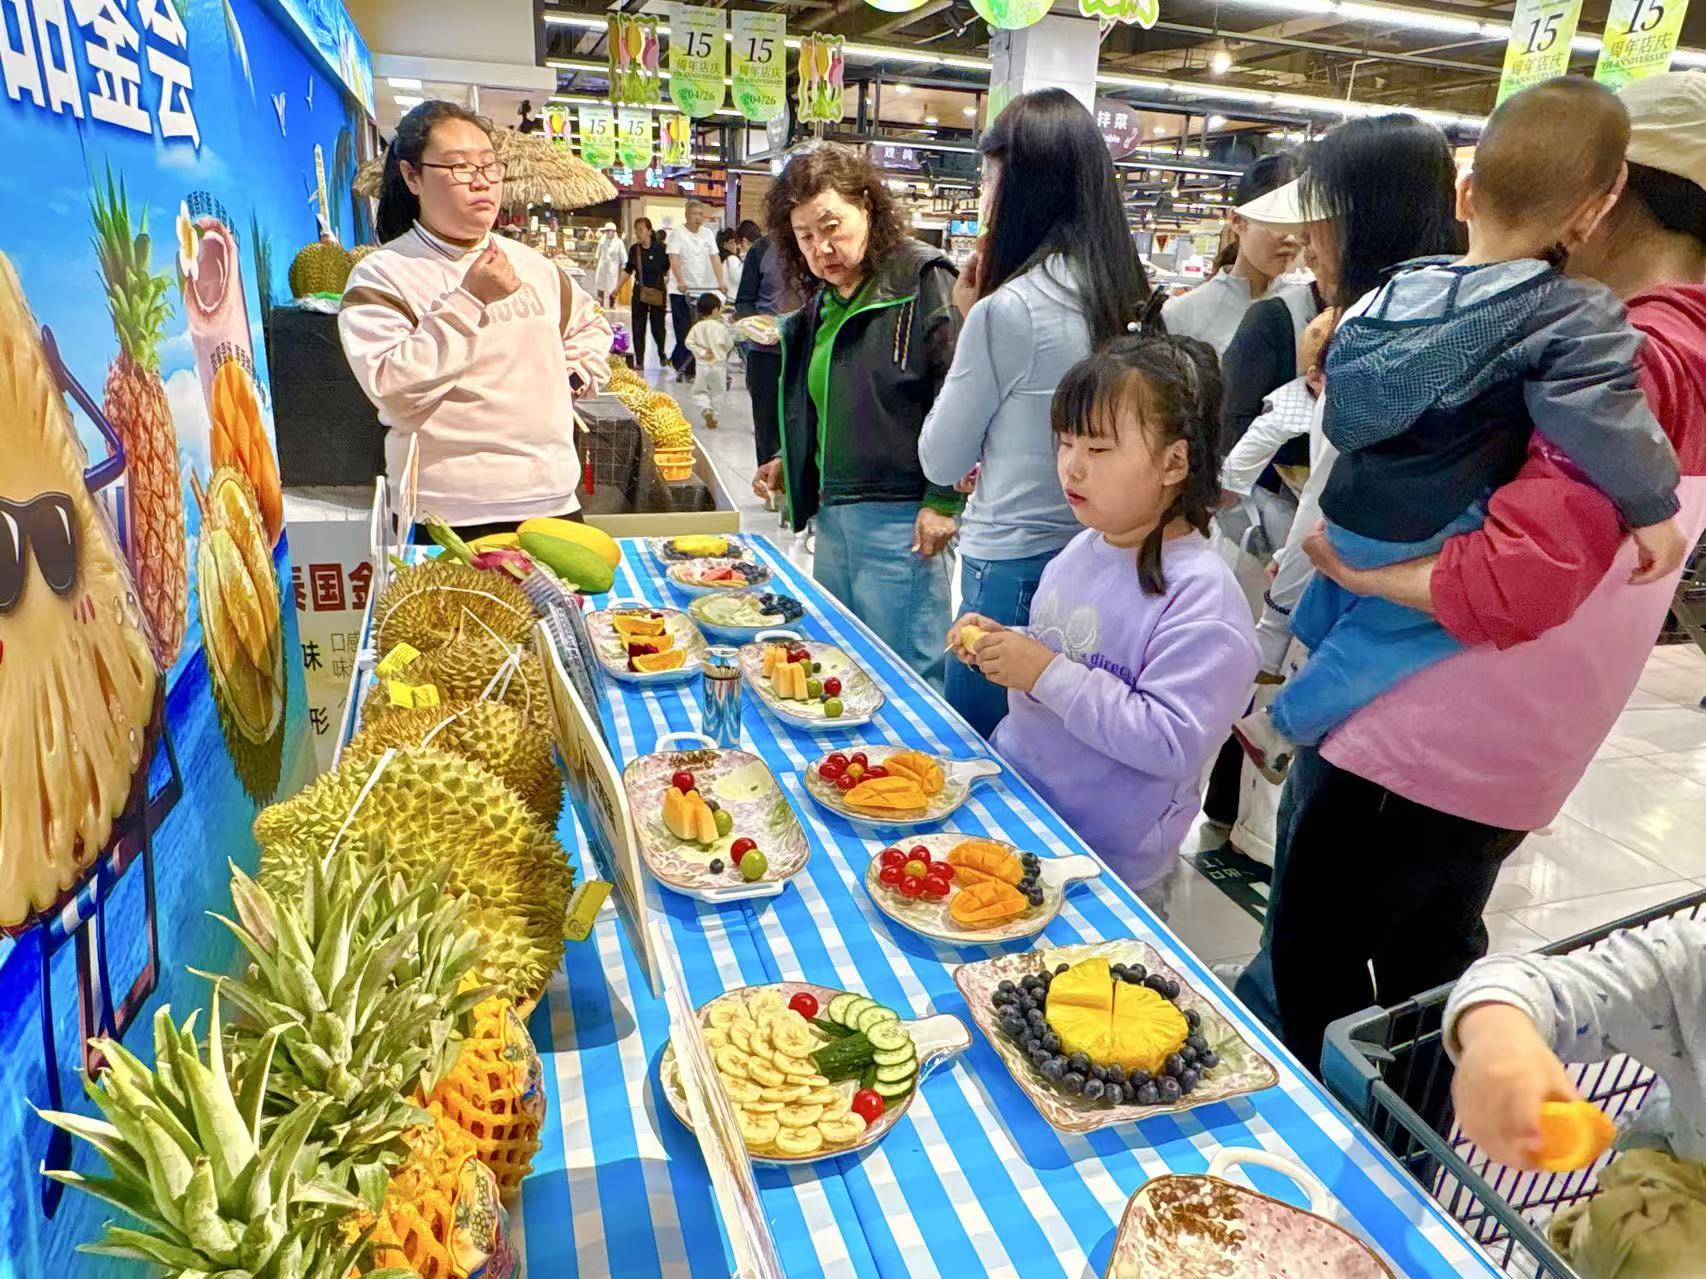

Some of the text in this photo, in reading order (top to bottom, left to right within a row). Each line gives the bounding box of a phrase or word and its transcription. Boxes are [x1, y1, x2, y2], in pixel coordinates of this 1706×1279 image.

[1620, 0, 1664, 36] 15
[682, 31, 713, 58] 15
[1520, 13, 1564, 56] 15
[744, 37, 774, 64] 15
[687, 87, 715, 101] 04/26
[749, 94, 776, 106] 04/26
[590, 119, 607, 135] 15
[628, 120, 644, 136] 15
[301, 640, 323, 672] 味
[332, 658, 353, 680] 味
[309, 706, 331, 735] 形
